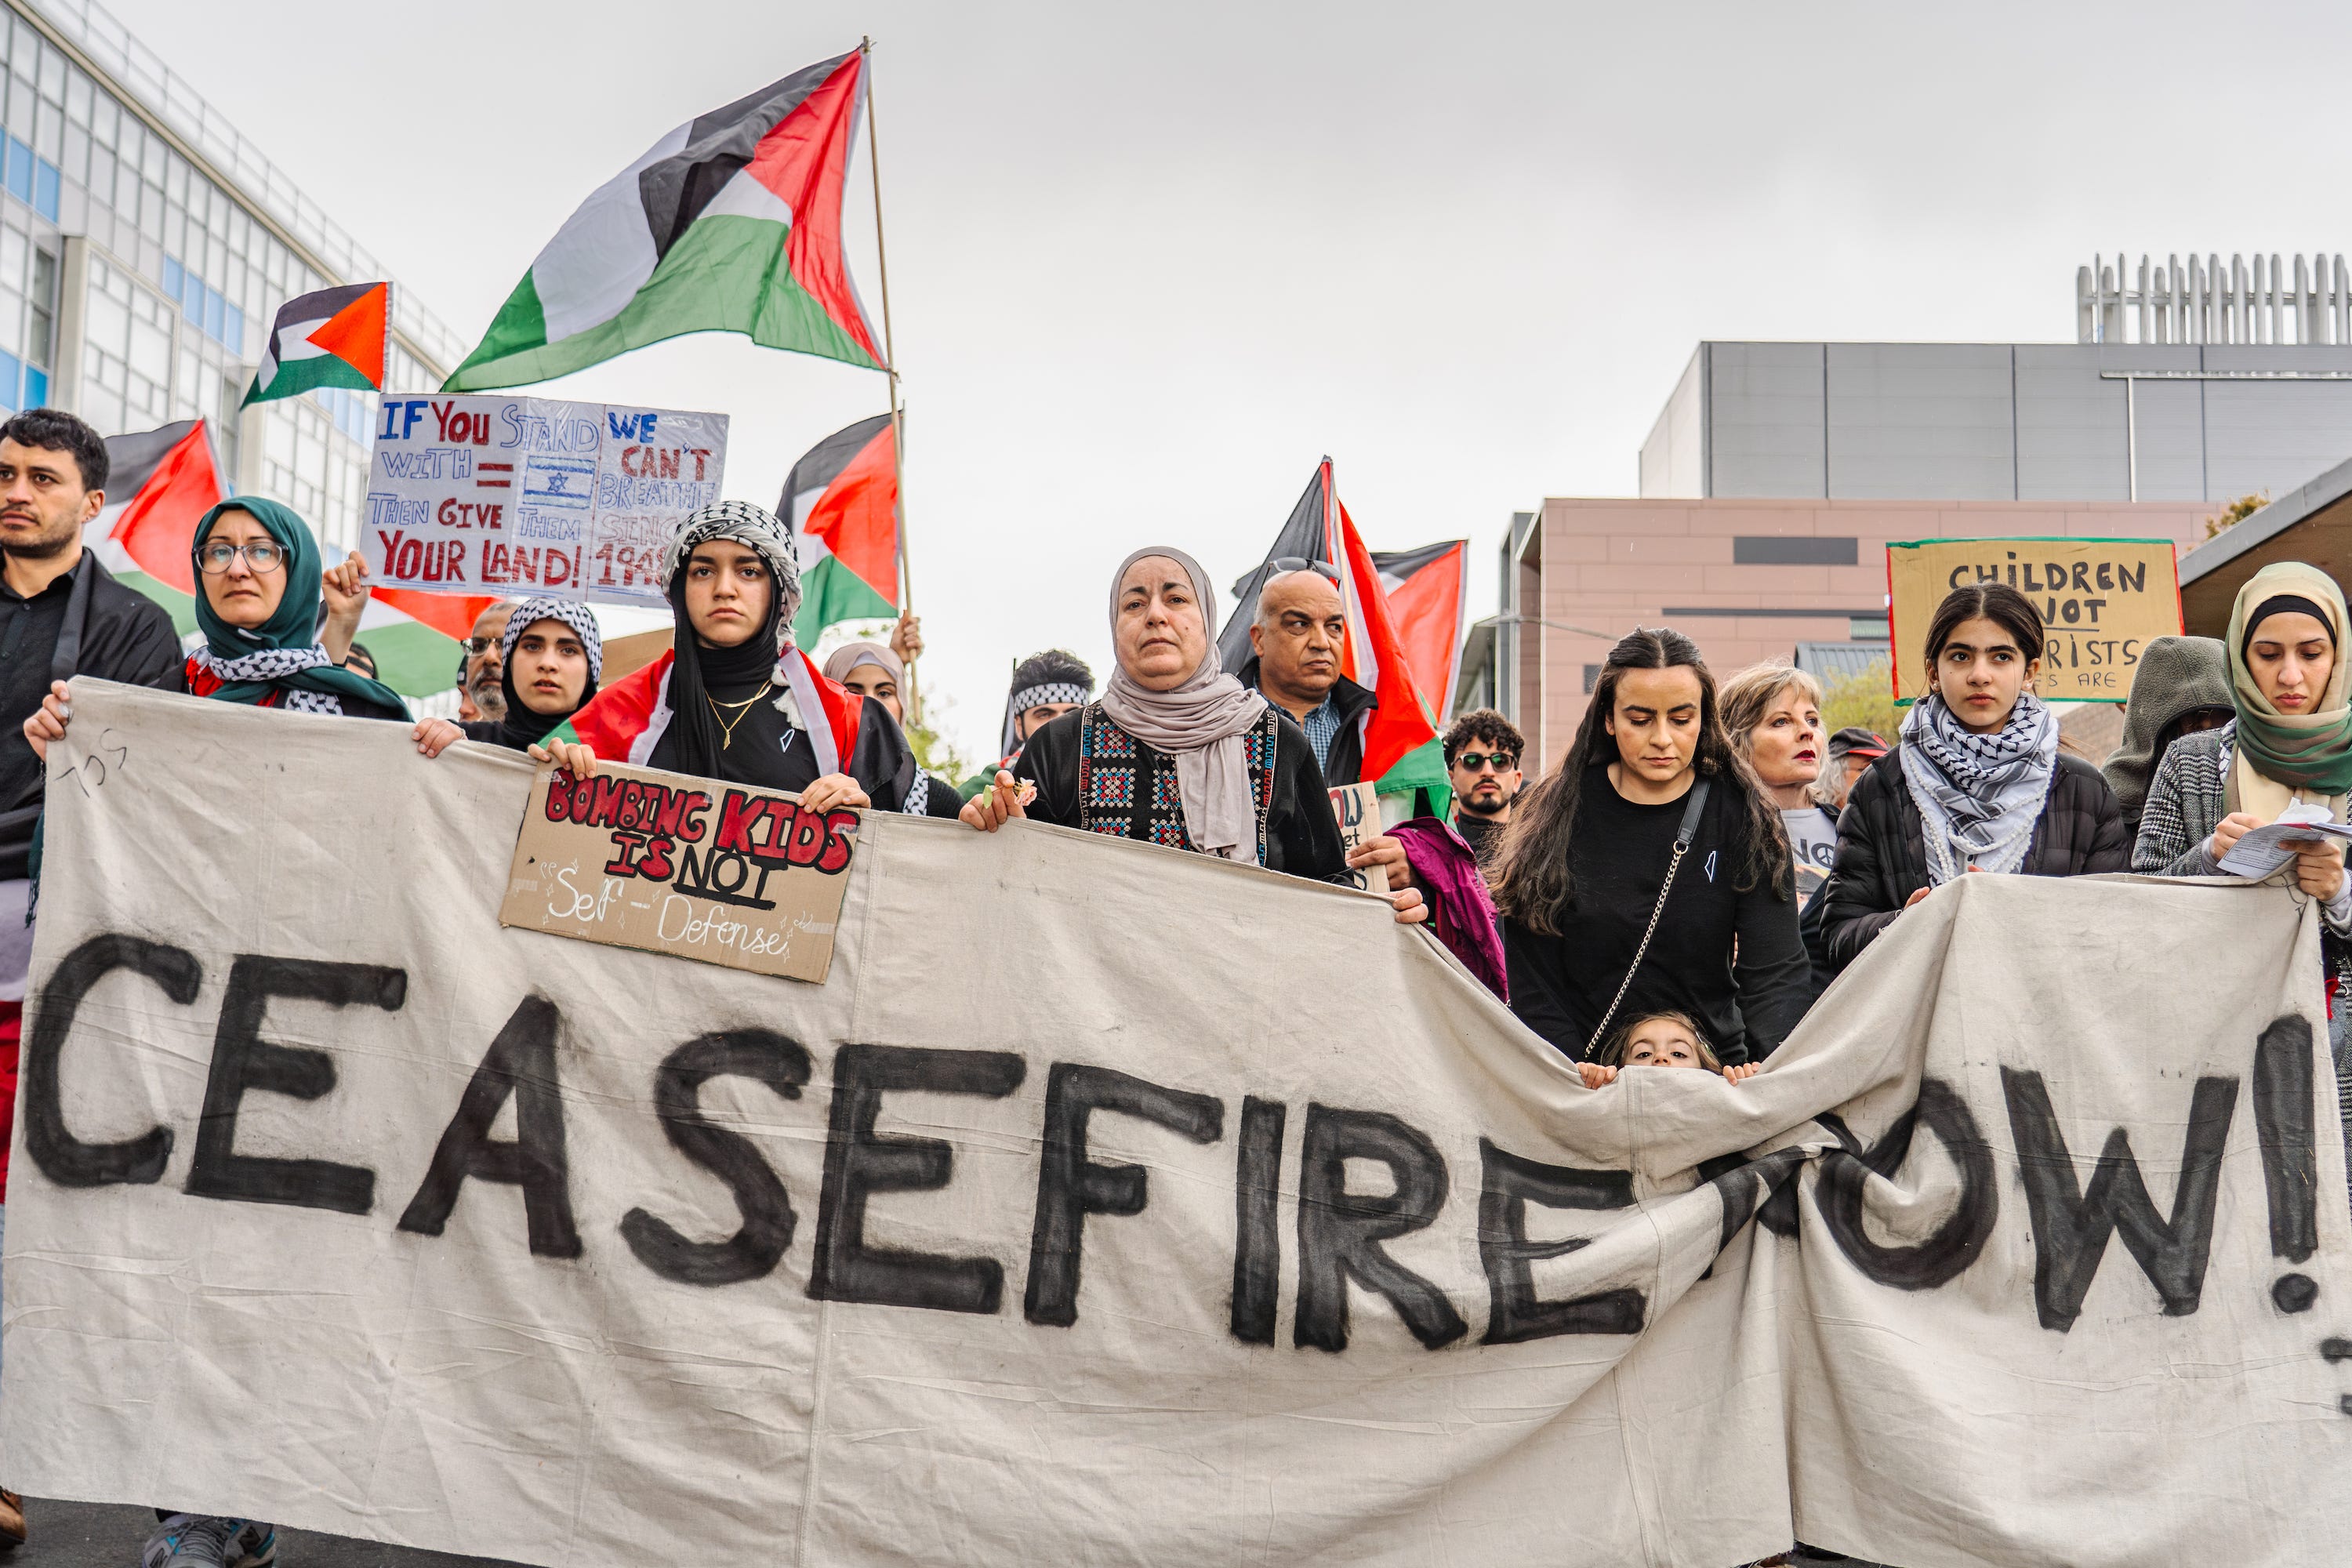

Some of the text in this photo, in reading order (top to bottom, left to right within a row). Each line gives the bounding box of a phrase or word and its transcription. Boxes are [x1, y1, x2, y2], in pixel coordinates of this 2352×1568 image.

[379, 401, 600, 452] IF YOU STAND
[608, 412, 658, 444] WE
[381, 448, 471, 479] WITH
[621, 441, 713, 481] CAN'T
[598, 473, 715, 510] BREATHE
[367, 492, 581, 541] THEN GIVE THEM
[598, 514, 678, 546] SINC
[378, 530, 582, 588] YOUR LAND!
[2031, 597, 2107, 625] NOT
[2078, 672, 2117, 688] ARE
[545, 768, 862, 875] BOMBING KIDS
[604, 831, 789, 902] IS NOT
[24, 932, 1646, 1351] CEASEFIRE
